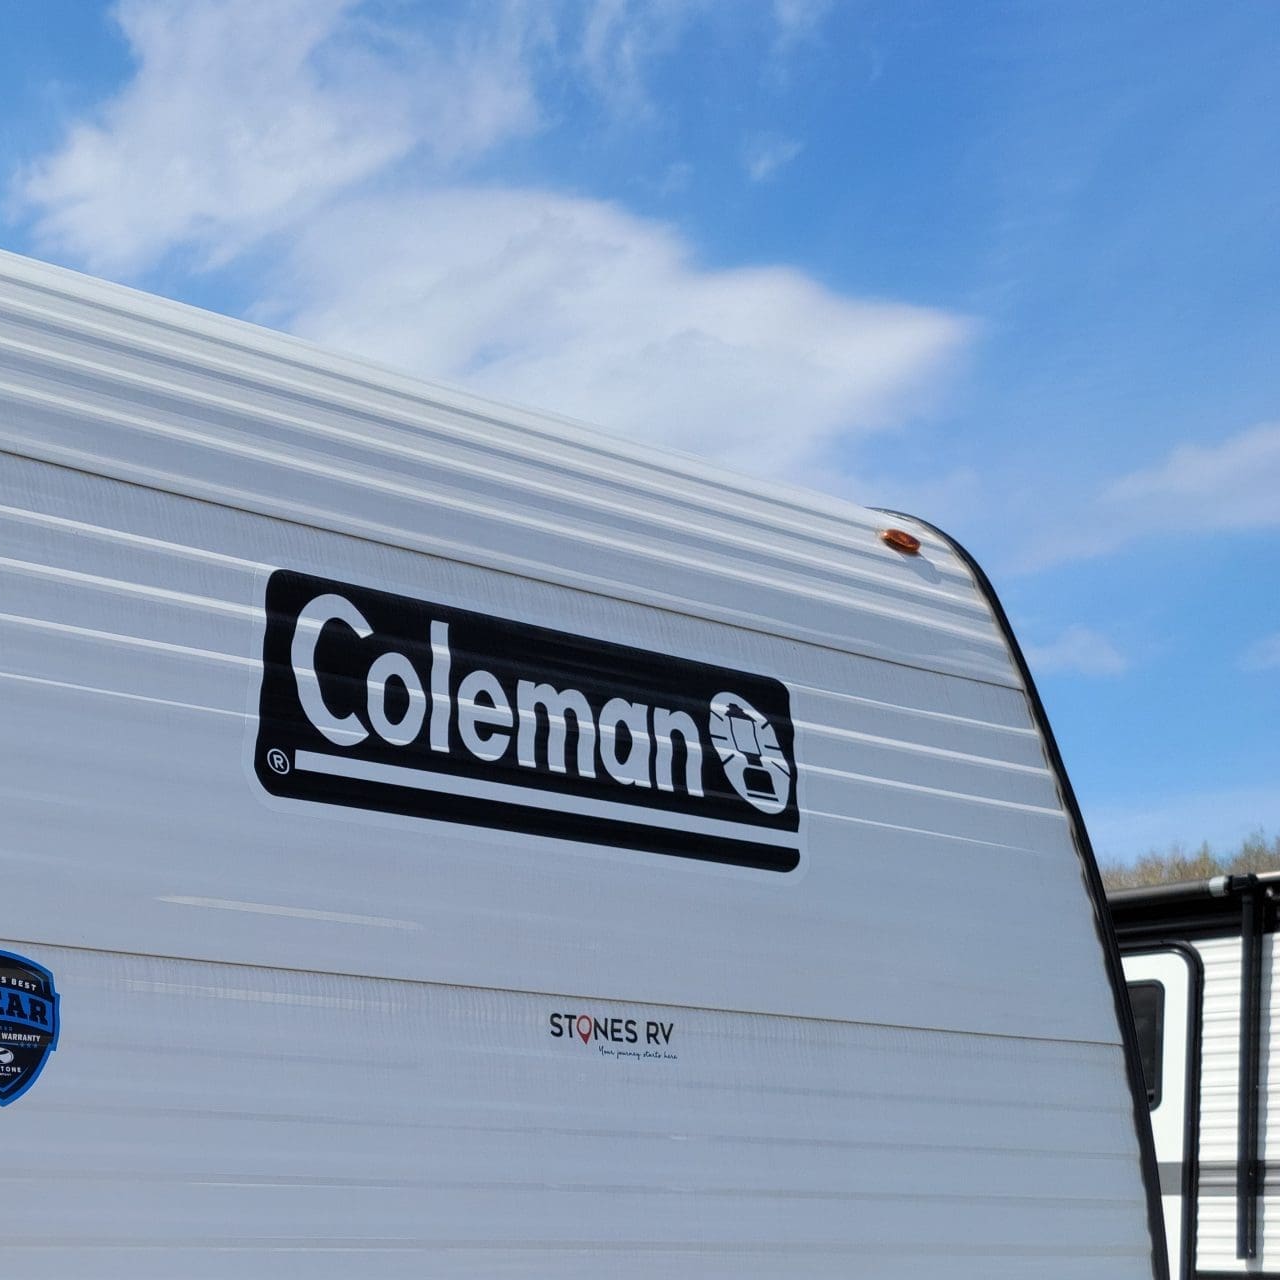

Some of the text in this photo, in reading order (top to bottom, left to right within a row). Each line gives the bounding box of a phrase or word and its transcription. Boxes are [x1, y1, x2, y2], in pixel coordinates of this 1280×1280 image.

[291, 593, 704, 797] Coleman
[11, 978, 37, 992] BEST
[1, 1032, 41, 1043] WARRANTY
[549, 1013, 674, 1045] STONES RV
